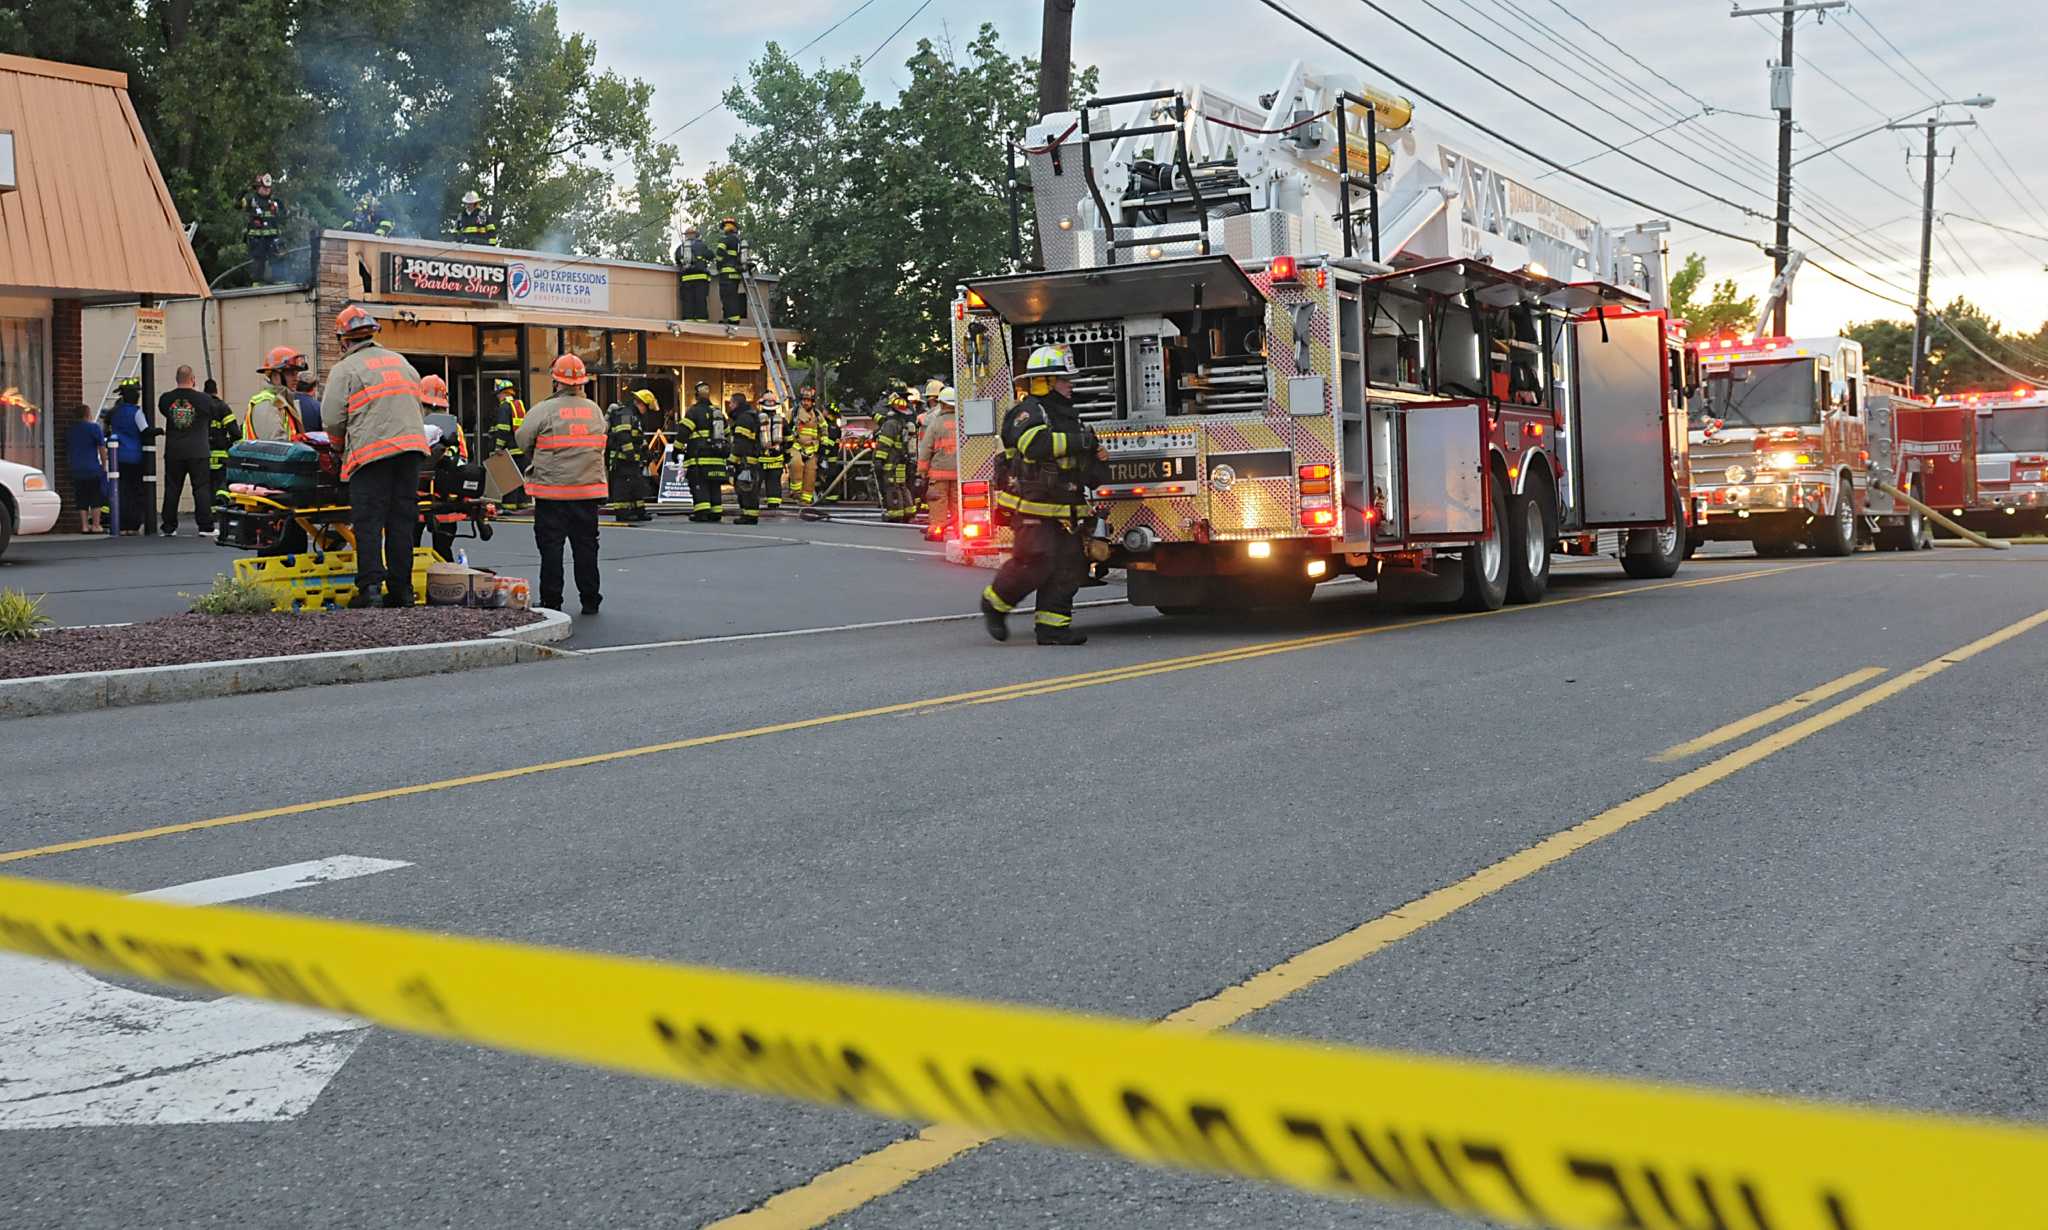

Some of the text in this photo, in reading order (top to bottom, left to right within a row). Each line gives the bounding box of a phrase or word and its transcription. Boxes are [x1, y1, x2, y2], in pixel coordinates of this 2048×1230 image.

[533, 268, 607, 285] GIO EXPRESSIONS
[408, 272, 501, 299] Barber Shop
[533, 281, 591, 297] PRIVATE SPA
[1109, 463, 1157, 480] TRUCK
